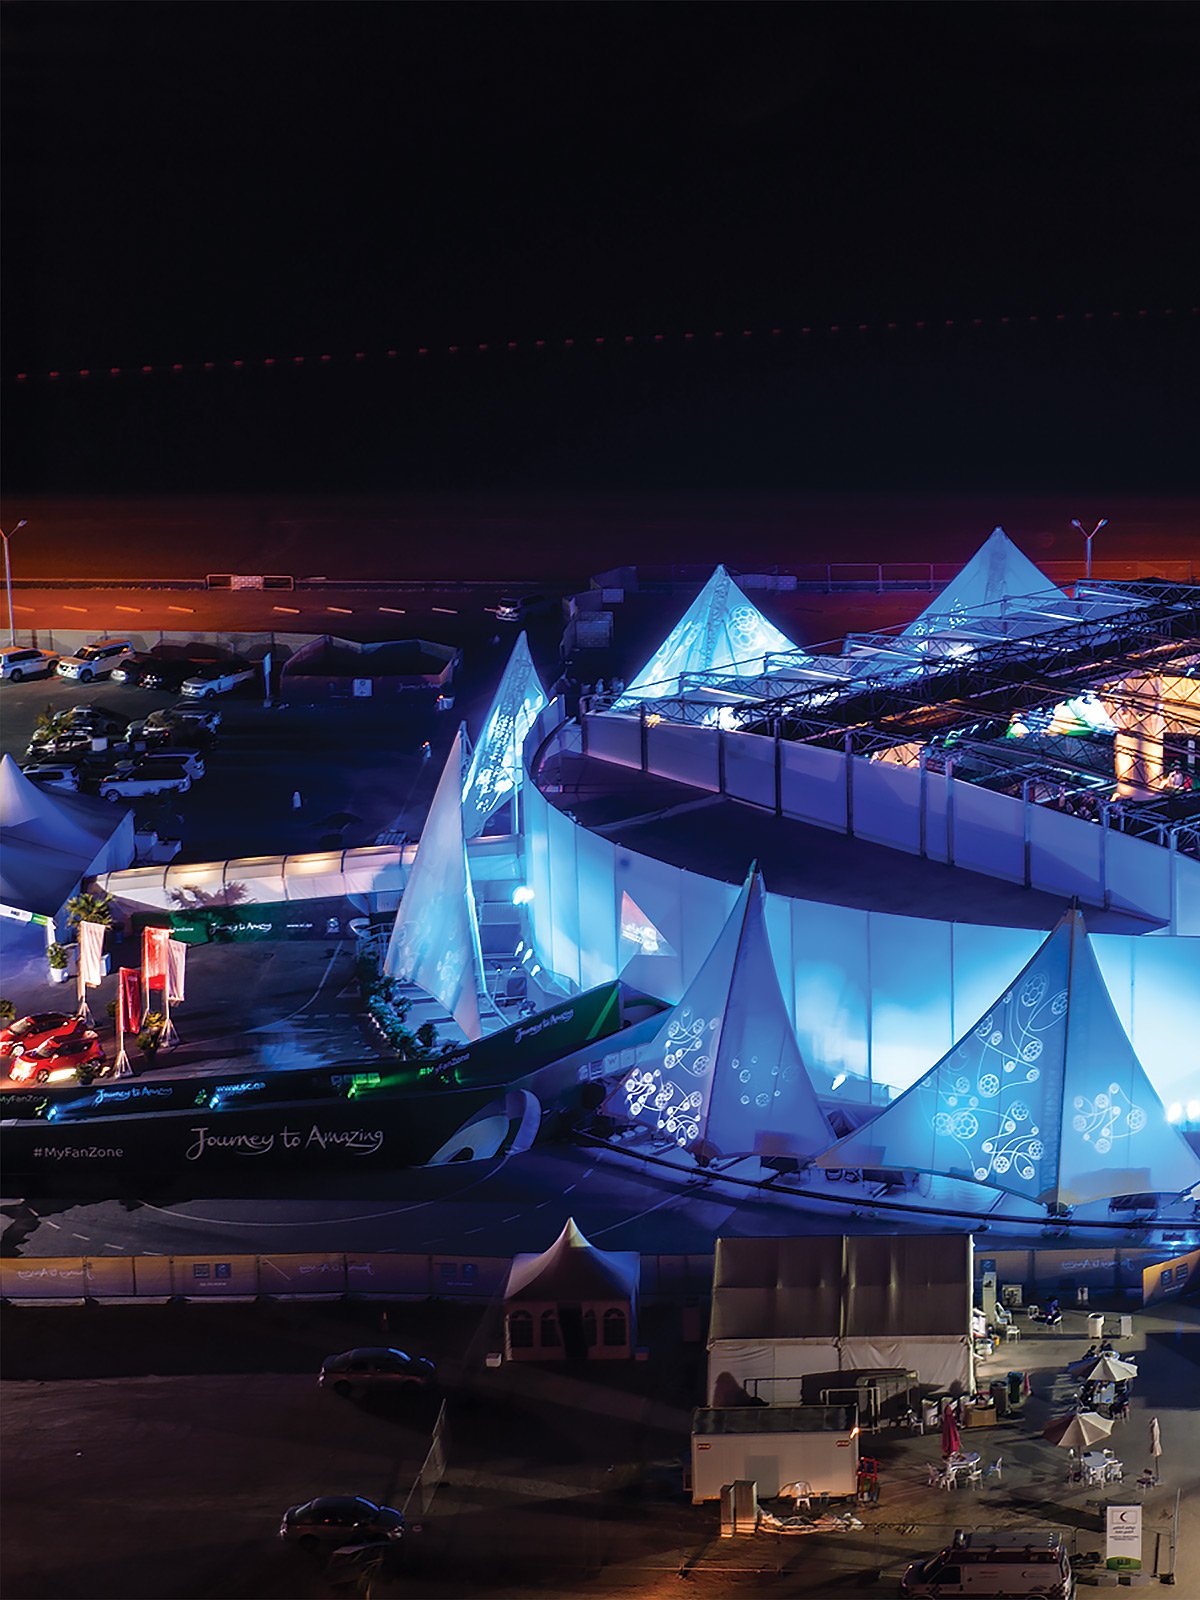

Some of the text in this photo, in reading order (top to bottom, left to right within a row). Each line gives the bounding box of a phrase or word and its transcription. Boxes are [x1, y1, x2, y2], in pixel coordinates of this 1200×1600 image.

[95, 1086, 173, 1104] Journey to Amazing
[185, 1124, 384, 1161] Journey to Amazing
[33, 1147, 124, 1160] #MyFanZone
